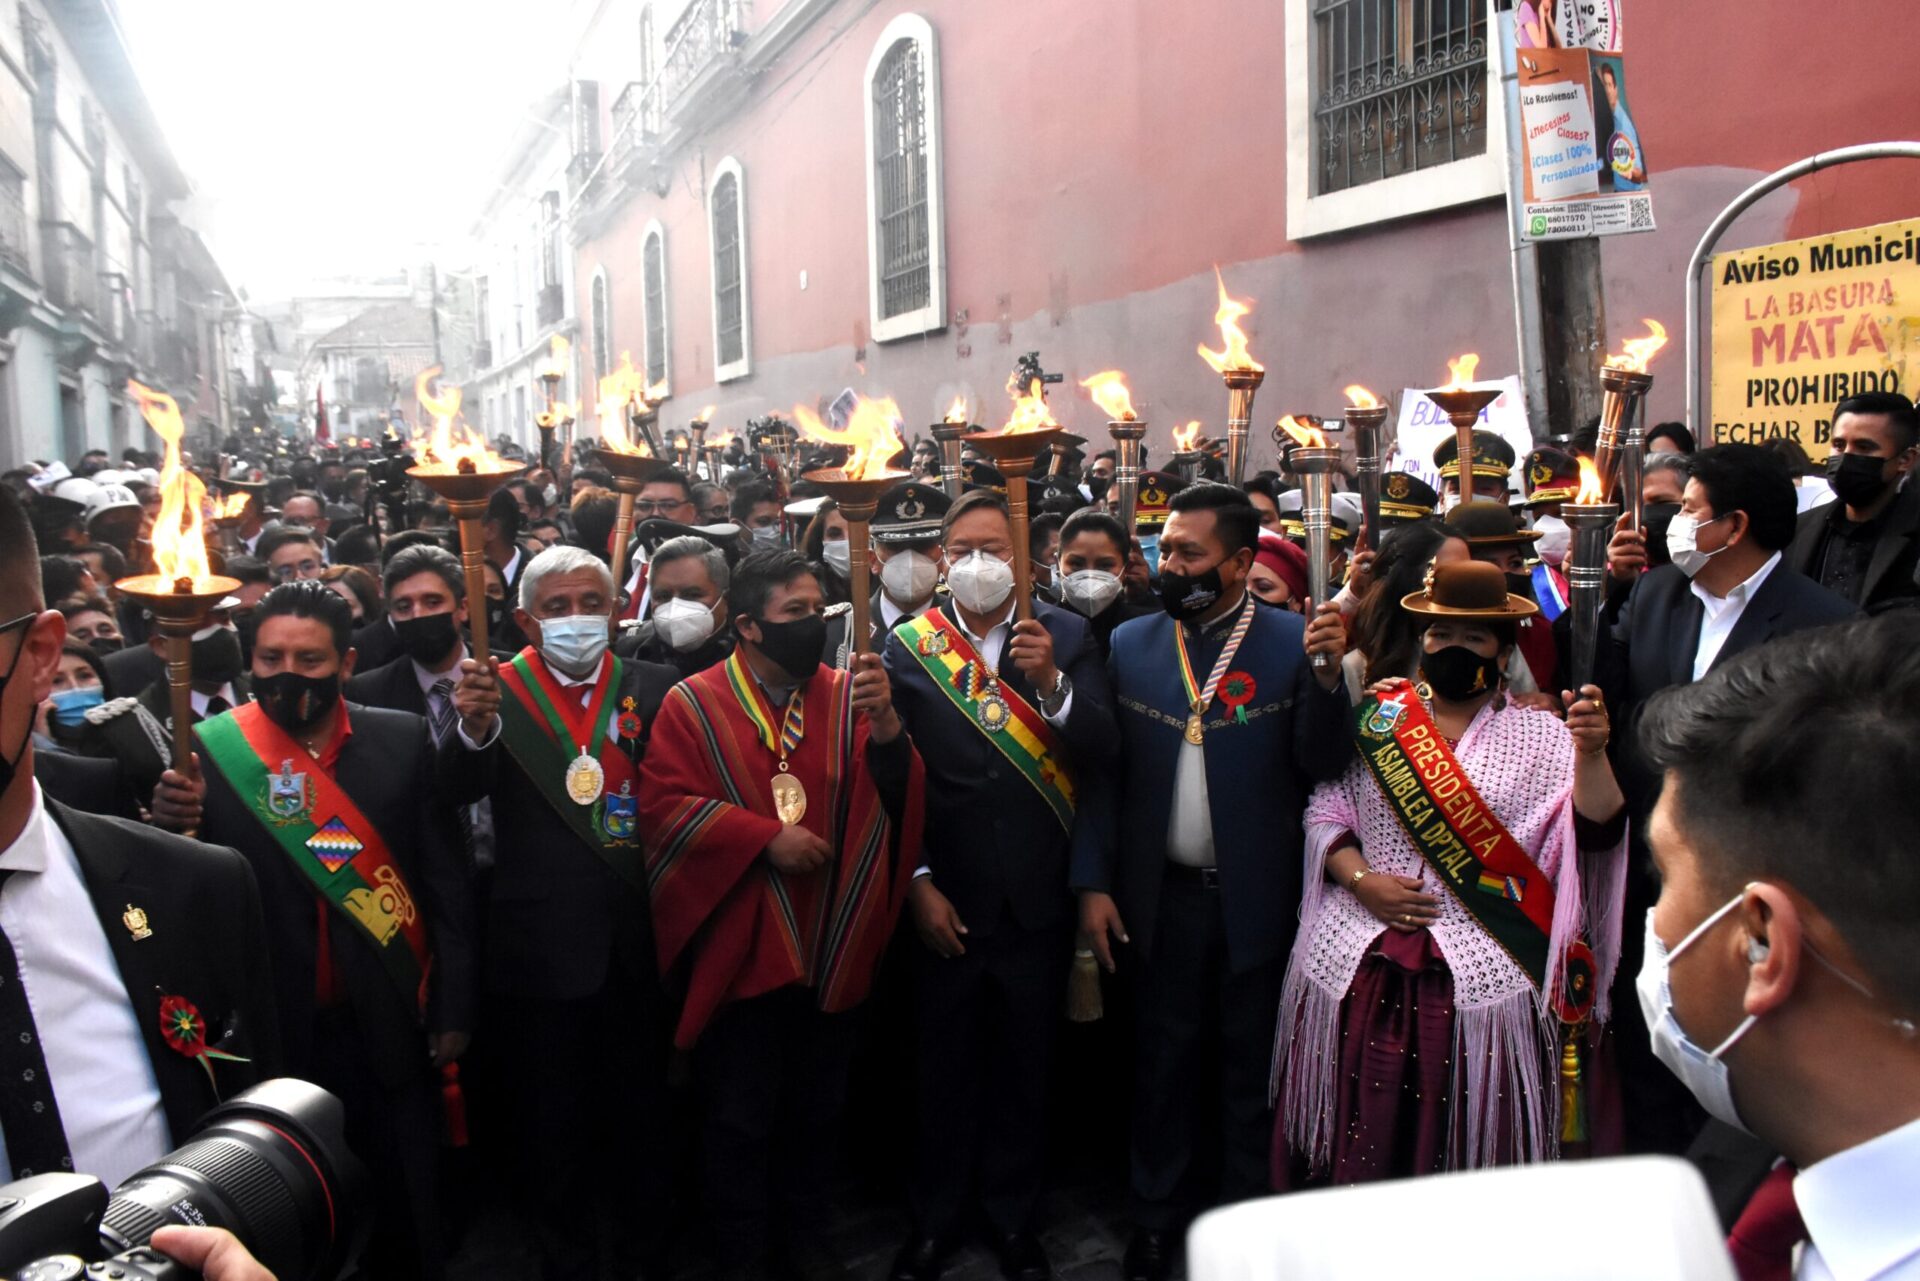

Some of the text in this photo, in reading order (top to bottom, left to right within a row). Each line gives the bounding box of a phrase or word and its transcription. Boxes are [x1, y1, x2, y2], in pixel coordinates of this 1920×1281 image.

[1535, 89, 1578, 103] Resolvemos!
[1557, 127, 1590, 141] Clases?
[1566, 143, 1592, 160] 100%
[1723, 230, 1920, 285] Aviso Munici
[1745, 278, 1894, 321] LA BASURA
[1751, 312, 1887, 368] MATA
[1747, 369, 1899, 408] PROHIBIDO
[1714, 420, 1802, 445] ECHAR
[1400, 724, 1502, 858] PRESIDENTA
[1371, 742, 1474, 885] ASAMBLEA DPTAL.
